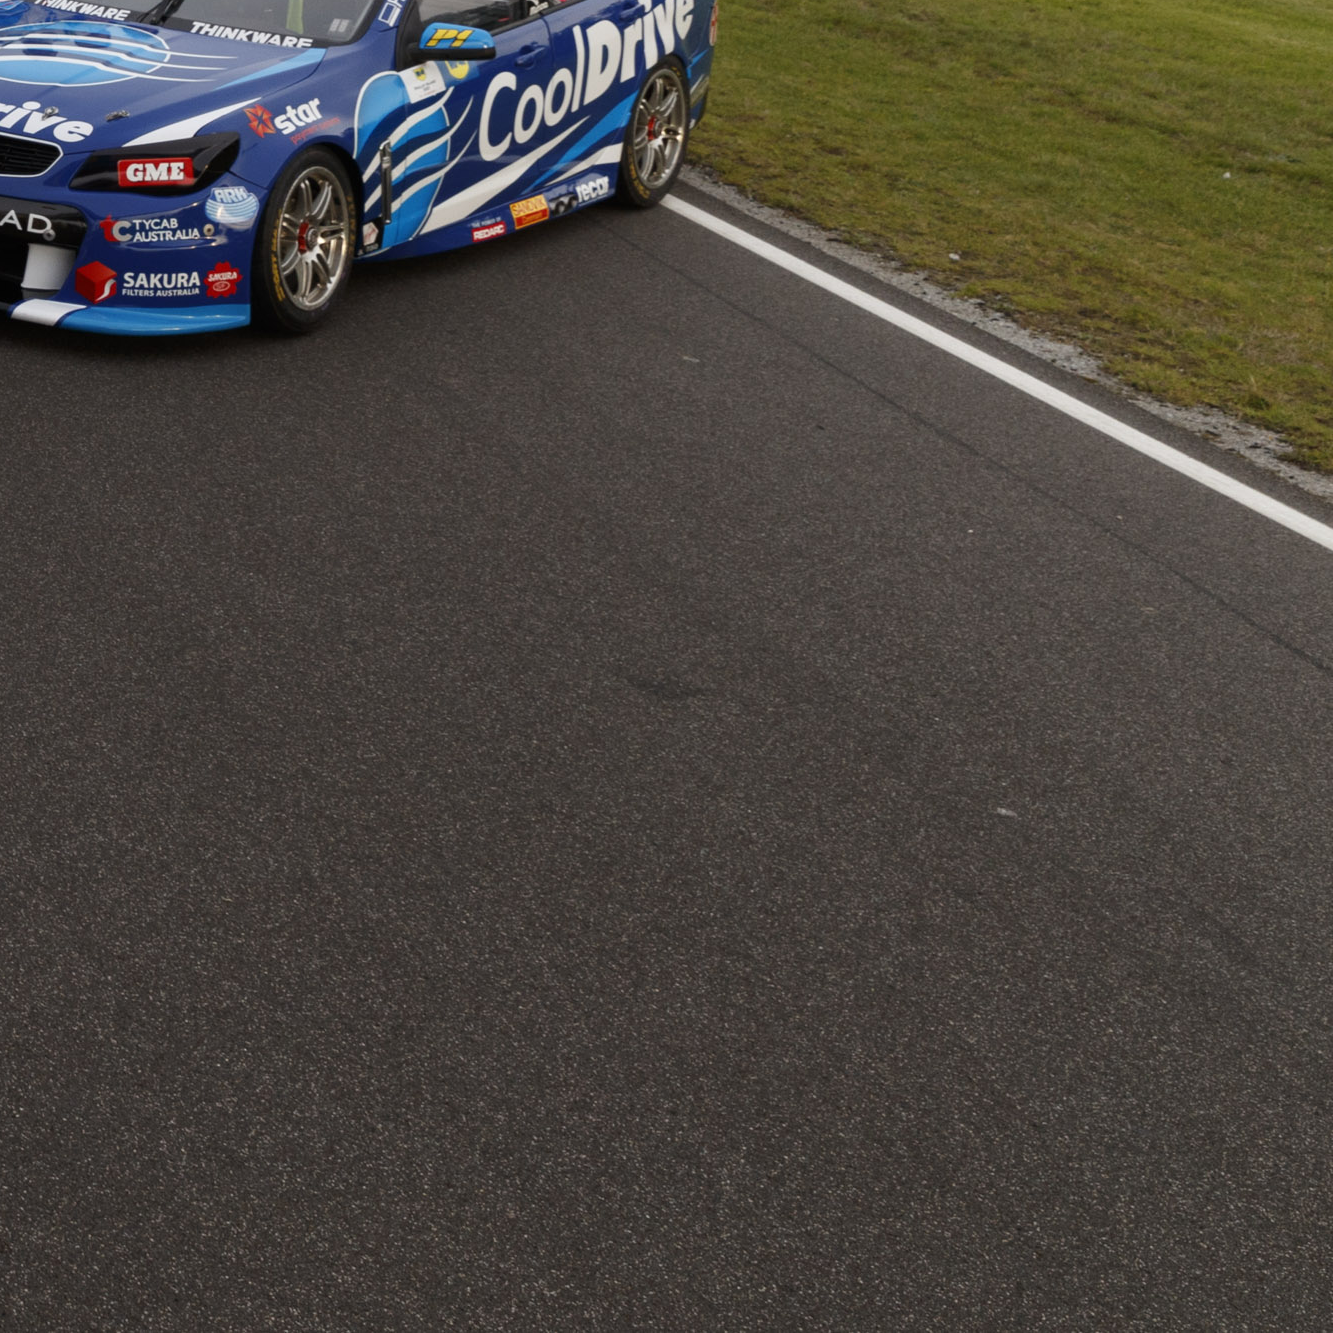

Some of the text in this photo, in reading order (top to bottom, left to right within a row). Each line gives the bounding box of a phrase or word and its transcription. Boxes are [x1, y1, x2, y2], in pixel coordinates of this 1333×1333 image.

[189, 20, 314, 49] THINKWARE
[274, 97, 323, 136] star
[125, 161, 186, 183] GME
[215, 187, 248, 203] ARK
[510, 196, 546, 217] SANDVIK
[133, 218, 179, 230] TYCAB
[472, 224, 505, 241] REDARC
[133, 228, 201, 243] AUSTRALIA
[122, 271, 201, 289] SAKURA
[207, 271, 238, 283] SAKURA
[121, 286, 201, 298] FILTERS AUSTRALIA
